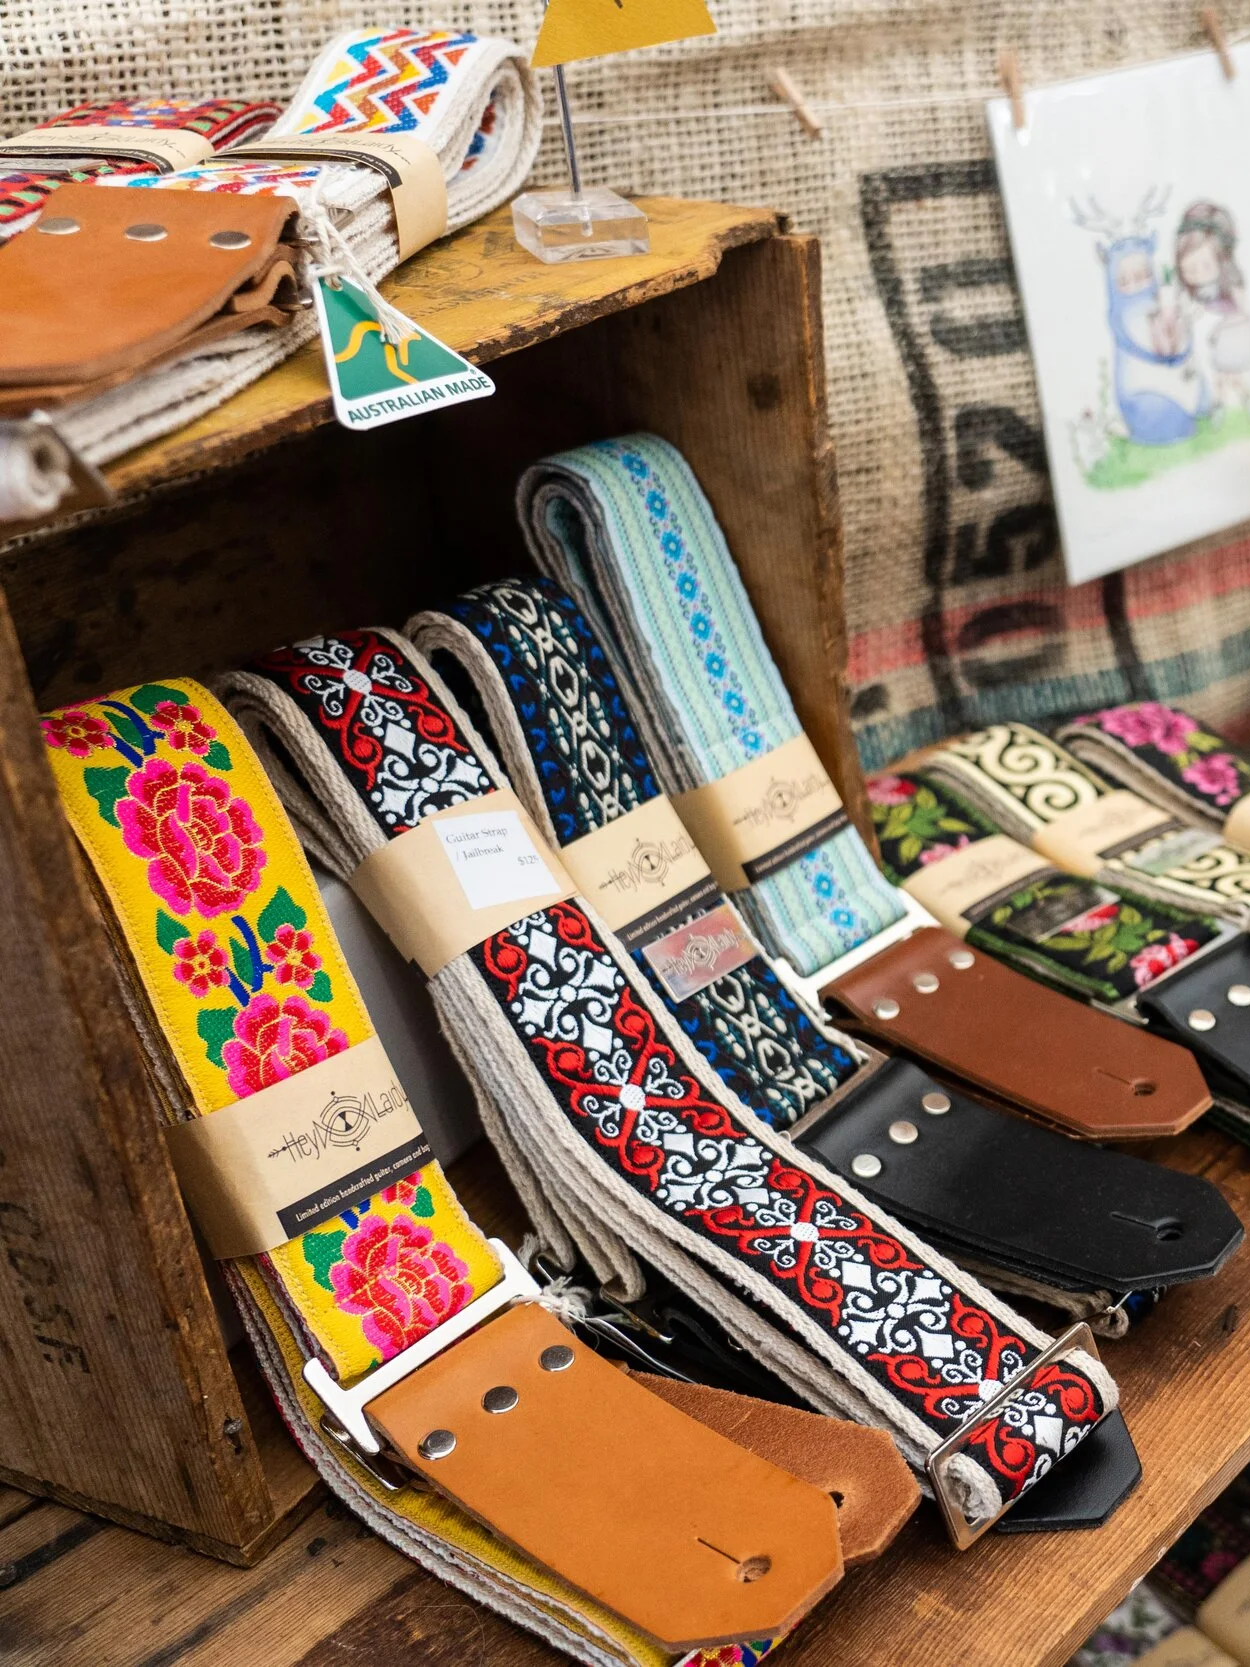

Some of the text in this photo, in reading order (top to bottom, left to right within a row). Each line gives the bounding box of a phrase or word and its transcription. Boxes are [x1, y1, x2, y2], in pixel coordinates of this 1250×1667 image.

[348, 376, 491, 423] AUSTRALIAN MADE
[446, 827, 508, 844] Guitar Strap
[462, 844, 504, 861] Jailbreak
[282, 1131, 320, 1162] Hey
[296, 1204, 319, 1222] Limited
[320, 1195, 340, 1210] edition
[340, 1174, 375, 1198] handcrafted
[392, 1155, 412, 1170] camera
[412, 1147, 421, 1159] and
